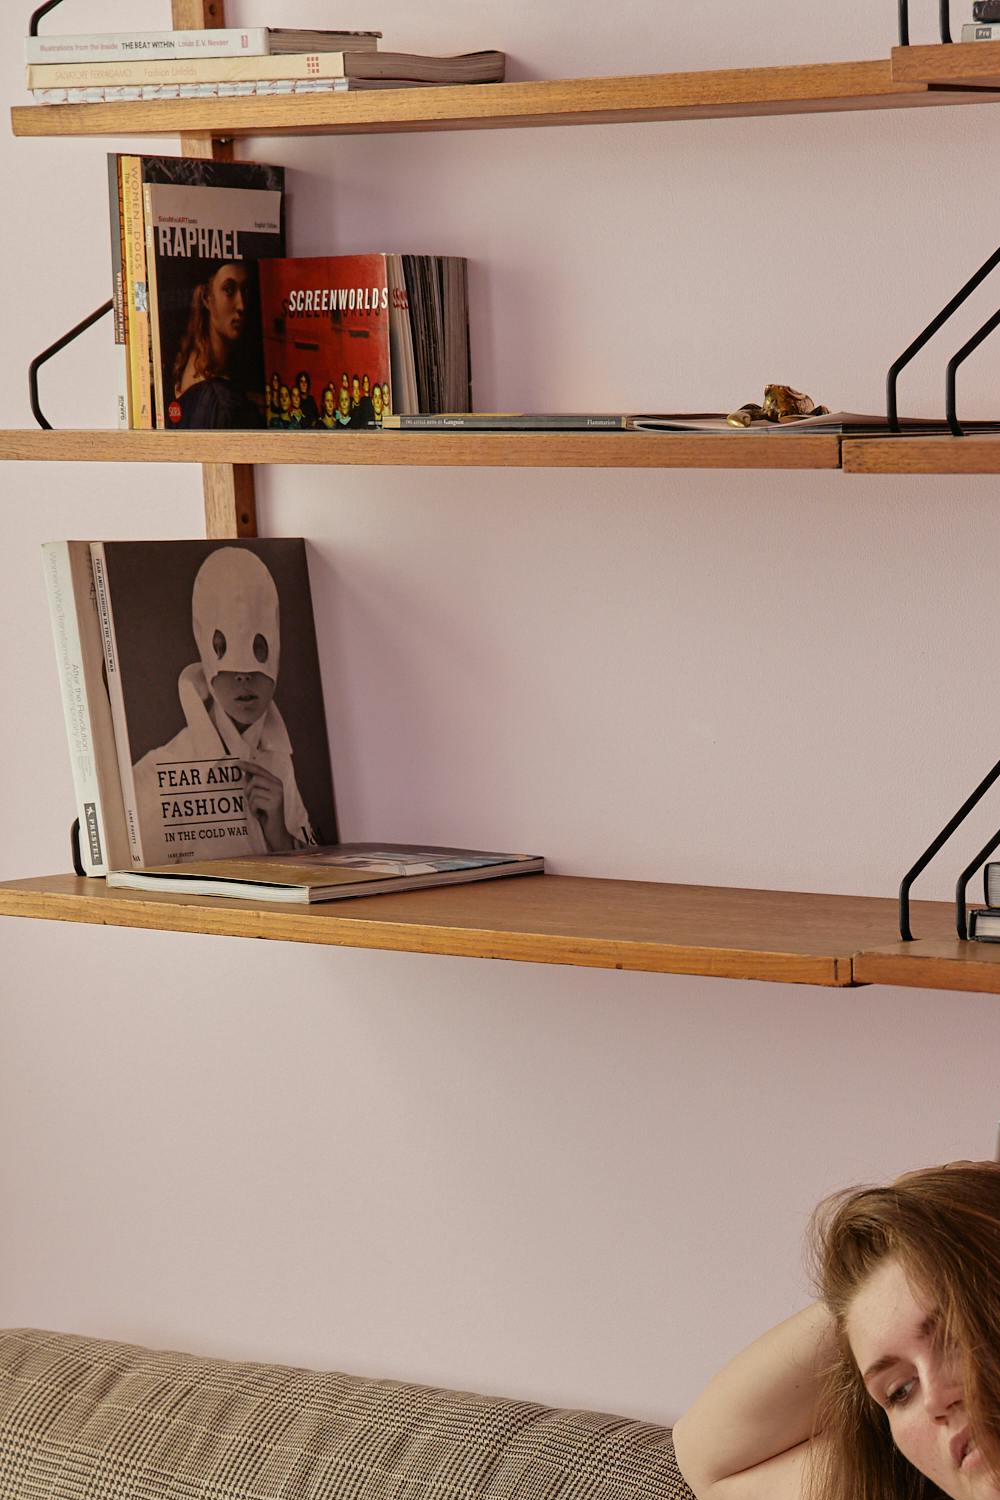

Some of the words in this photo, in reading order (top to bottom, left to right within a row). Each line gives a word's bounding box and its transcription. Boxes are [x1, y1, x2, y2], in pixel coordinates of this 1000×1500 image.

[121, 42, 134, 50] THE
[134, 41, 150, 49] BEAT
[151, 40, 175, 49] WITHIN
[131, 167, 140, 220] WOMEN
[134, 231, 142, 270] DOGS
[158, 226, 243, 260] RAPHAEL
[288, 287, 389, 311] SCREENWORLDS
[99, 589, 107, 617] FASHION
[72, 664, 81, 686] After
[75, 687, 83, 703] the
[78, 704, 89, 752] Revolution
[157, 768, 201, 788] FEAR
[207, 766, 243, 785] AND
[162, 796, 244, 819] FASHION
[88, 818, 100, 859] PRESTEL
[165, 832, 175, 843] IN
[178, 830, 196, 842] THE
[199, 828, 226, 840] COLD
[227, 826, 248, 837] WAR
